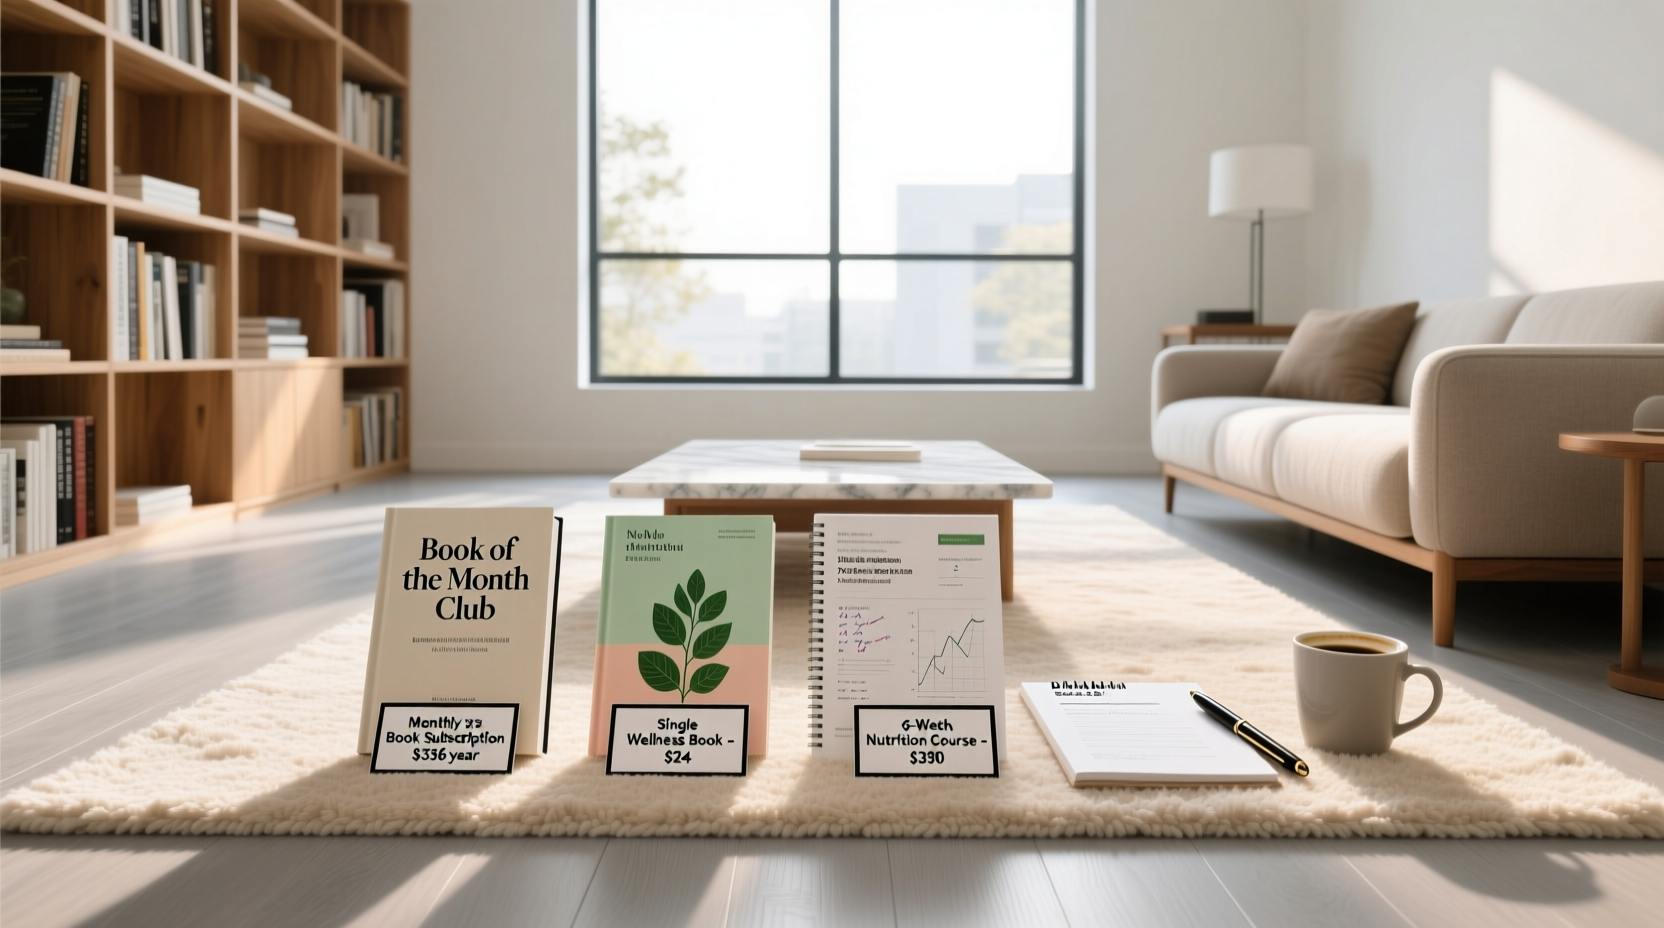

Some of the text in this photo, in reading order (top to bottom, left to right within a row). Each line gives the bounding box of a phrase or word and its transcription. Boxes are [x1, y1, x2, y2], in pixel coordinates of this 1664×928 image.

[419, 536, 519, 560] Book of
[402, 566, 529, 590] the Month
[436, 595, 495, 620] Club
[409, 716, 462, 731] Monthly
[658, 718, 698, 734] Single
[386, 732, 420, 744] Book
[627, 733, 685, 746] Wellness
[689, 734, 722, 746] Book
[867, 733, 927, 746] Nutrition
[931, 734, 977, 746] Course
[448, 752, 480, 764] year
[664, 750, 692, 764] $24
